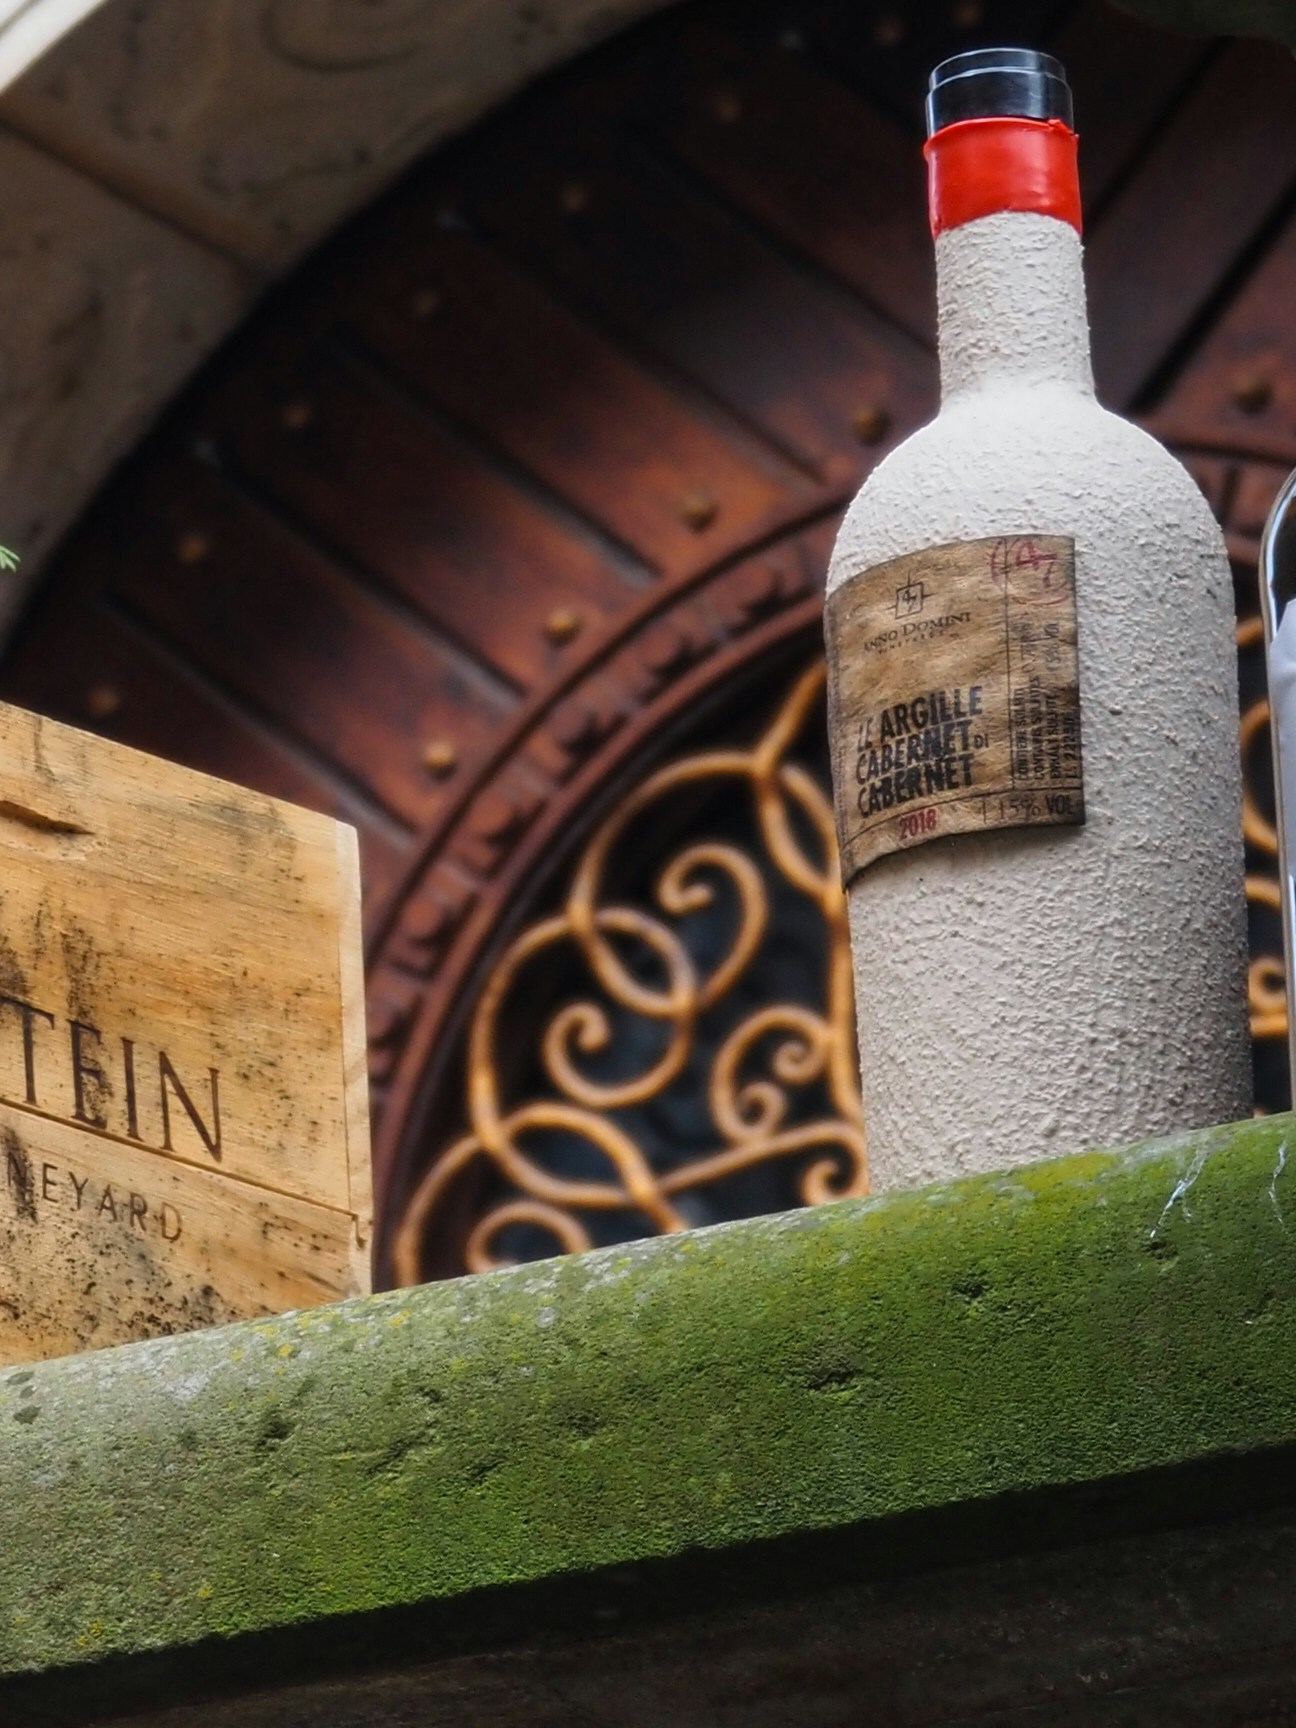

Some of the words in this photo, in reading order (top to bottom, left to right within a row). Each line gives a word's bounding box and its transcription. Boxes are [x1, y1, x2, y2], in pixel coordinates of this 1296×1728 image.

[901, 612, 971, 636] DOMINI
[879, 685, 983, 747] ARGILLE
[857, 720, 974, 785] CABERNET
[973, 733, 989, 750] DI
[858, 753, 975, 818] CABERNET
[899, 808, 938, 841] 2018
